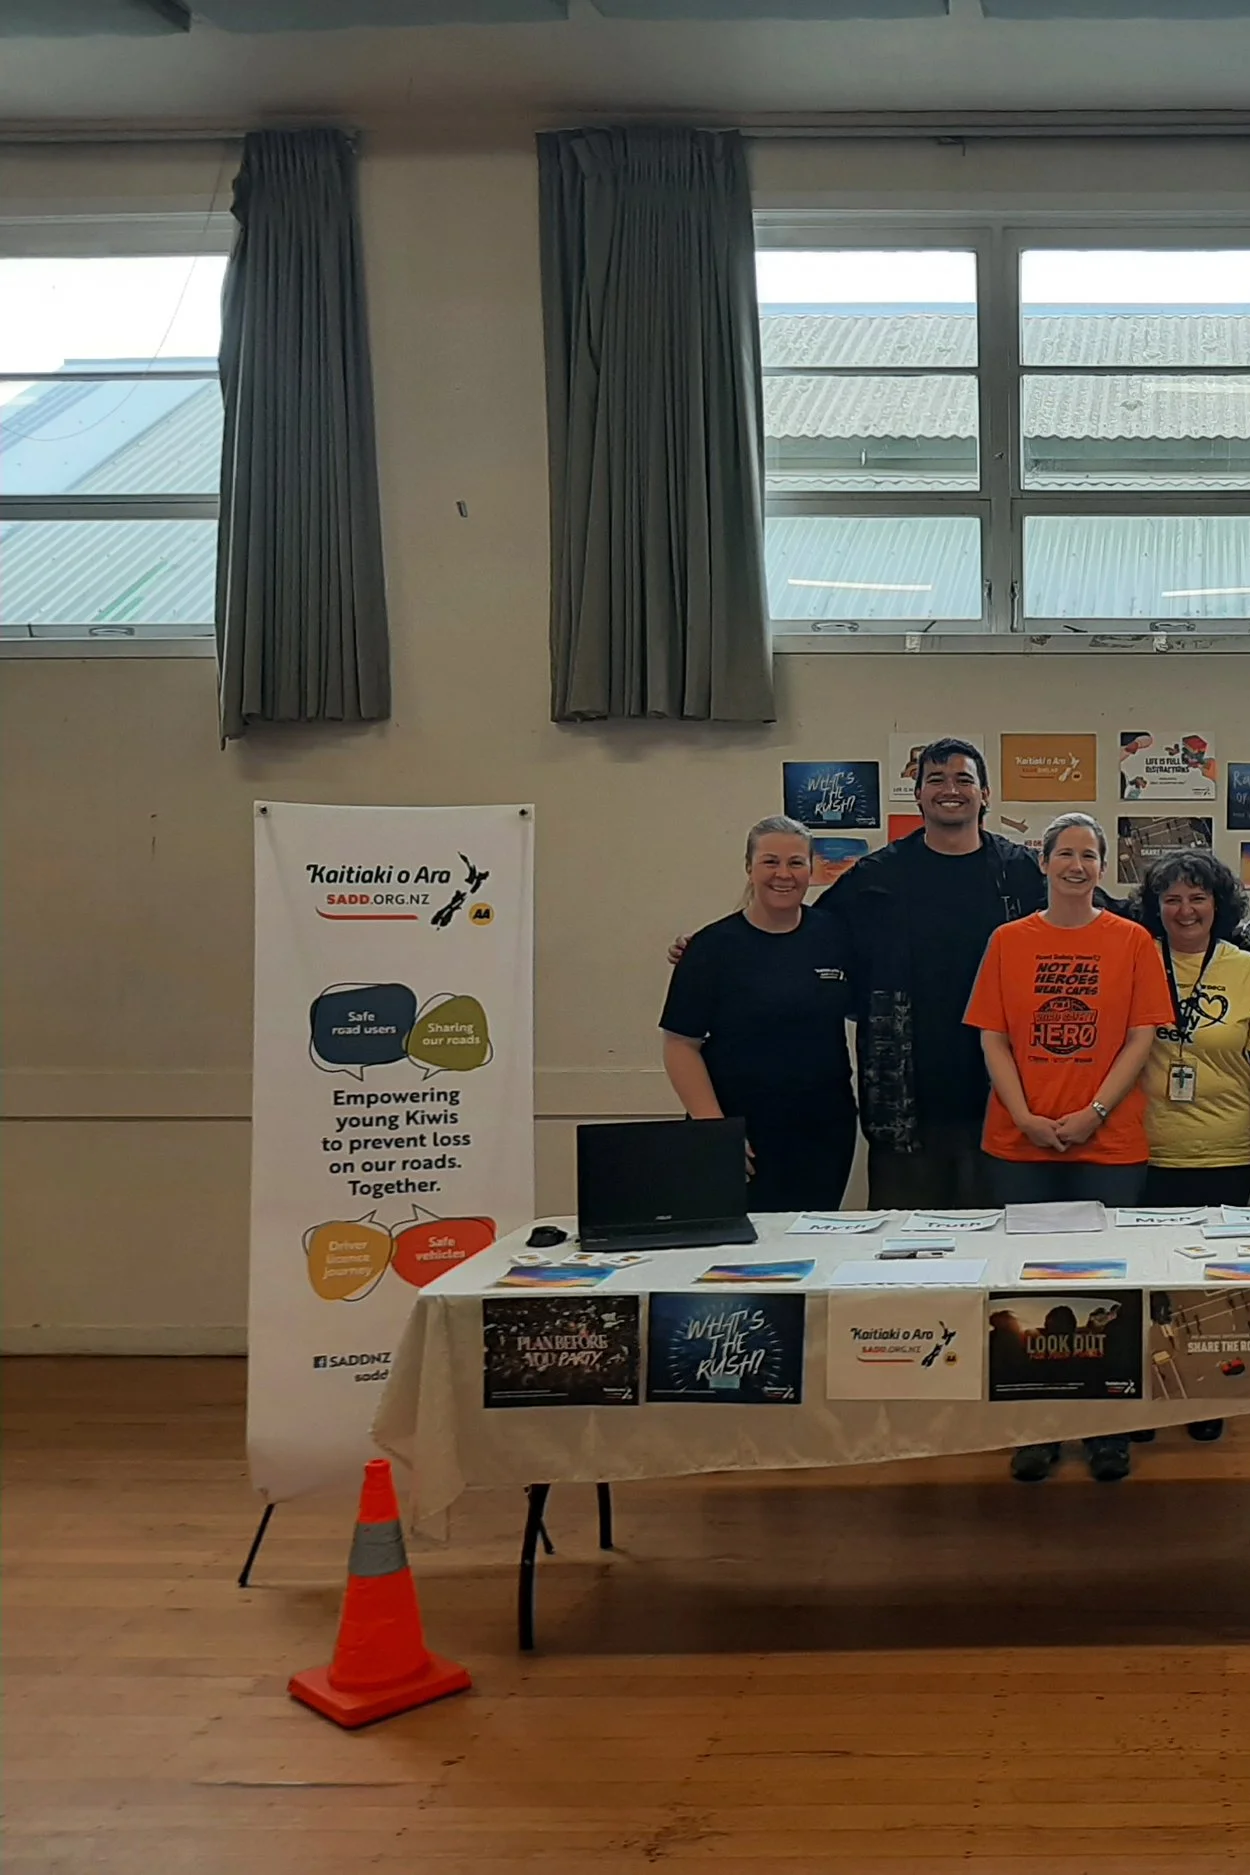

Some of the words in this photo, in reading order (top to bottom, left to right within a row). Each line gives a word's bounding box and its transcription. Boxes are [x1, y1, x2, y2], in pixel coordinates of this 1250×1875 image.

[807, 771, 855, 791] WHAT'S
[821, 785, 844, 802] THE
[306, 864, 392, 884] Kaitiaki
[397, 870, 410, 884] o
[413, 866, 451, 884] Ara
[327, 894, 430, 905] SADD.ORG.NZ
[473, 909, 491, 919] AA
[1036, 963, 1071, 973] NOT
[1073, 963, 1099, 973] ALL
[1034, 974, 1099, 985] HEROES
[1034, 985, 1063, 993] WEAR
[1065, 986, 1098, 995] CAPES
[348, 1011, 375, 1022] Safe
[332, 1025, 361, 1035] road
[364, 1025, 397, 1034] users
[427, 1023, 474, 1034] Sharing
[1156, 1027, 1194, 1043] eek
[422, 1037, 444, 1045] our
[446, 1035, 480, 1045] roads
[333, 1087, 461, 1108] Empowering
[336, 1115, 400, 1132] young
[406, 1109, 458, 1125] Kiwis
[322, 1137, 343, 1151] to
[350, 1133, 427, 1154] prevent
[433, 1132, 471, 1146] loss
[329, 1162, 354, 1174] on
[361, 1160, 396, 1172] our
[402, 1154, 462, 1171] roads.
[348, 1178, 441, 1199] Together.
[329, 1241, 368, 1251] Driver
[428, 1235, 456, 1247] Safe
[415, 1249, 466, 1261] vehicles
[687, 1309, 765, 1340] WHAT'S
[850, 1328, 899, 1340] Kaitiaki
[902, 1331, 910, 1340] o
[911, 1329, 933, 1340] Ara
[516, 1336, 553, 1351] PLAN
[555, 1333, 609, 1350] BEFORE
[709, 1331, 750, 1359] THE
[1026, 1334, 1070, 1354] LOOK
[1074, 1333, 1106, 1351] OUT
[1187, 1342, 1219, 1352] SHARE
[1221, 1341, 1239, 1352] THE
[329, 1352, 391, 1367] SADDNZ
[557, 1350, 604, 1367] PARTY
